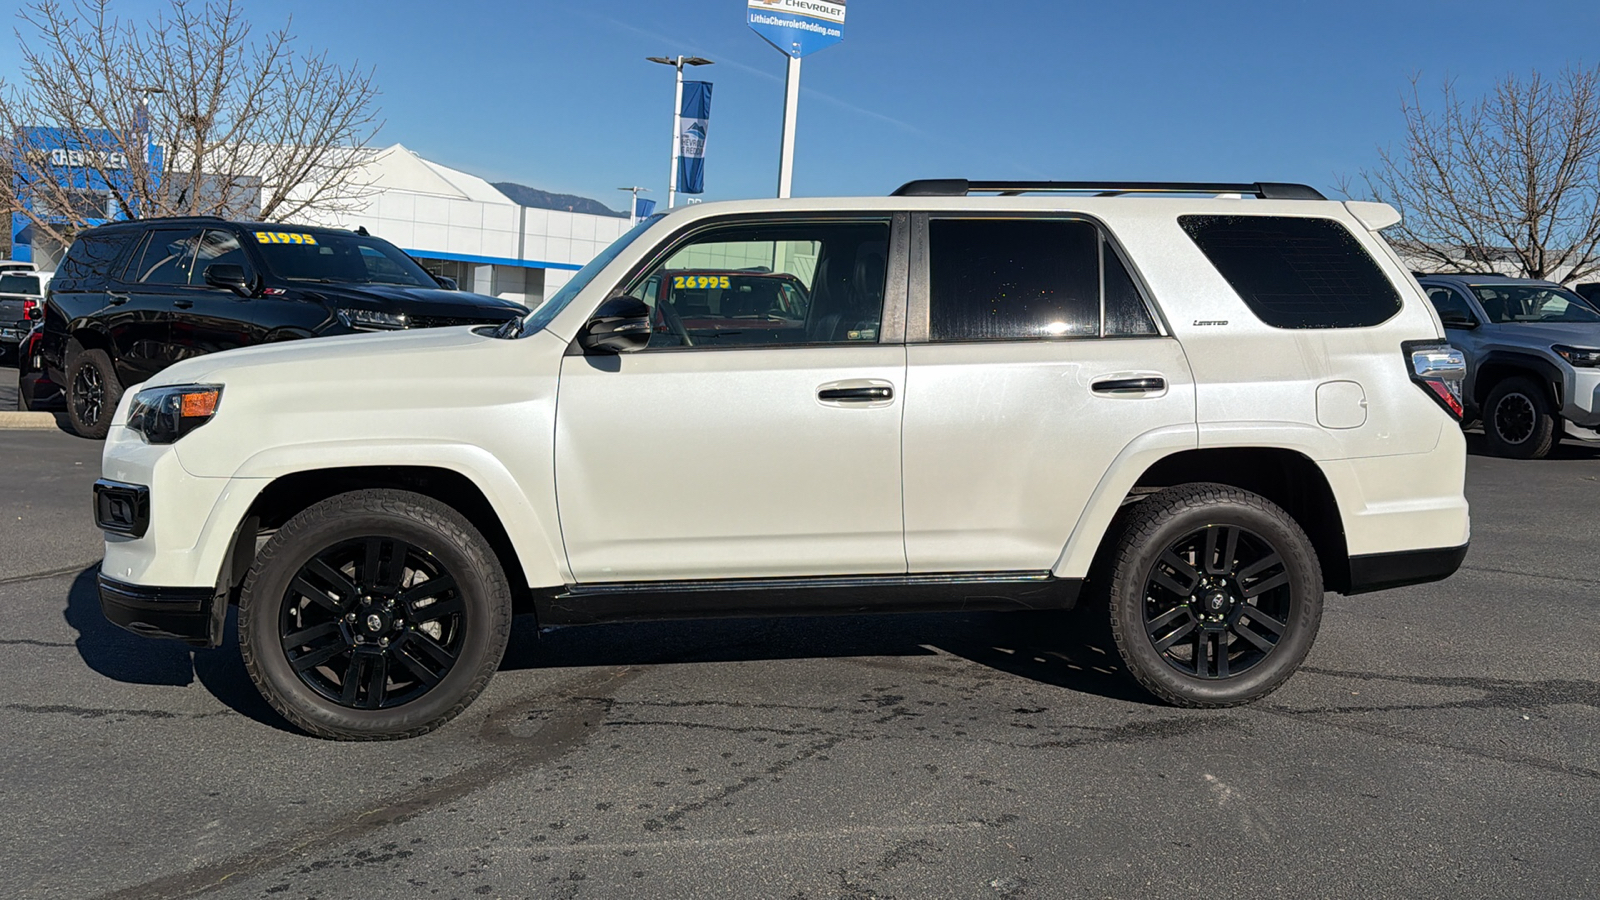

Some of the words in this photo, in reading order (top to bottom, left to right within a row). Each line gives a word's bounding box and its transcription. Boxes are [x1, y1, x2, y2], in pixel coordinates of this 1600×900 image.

[785, 0, 842, 16] CHEVROLET
[750, 13, 841, 37] LithiaChevroletRedding.com
[255, 231, 317, 245] 51995
[674, 276, 730, 289] 26995
